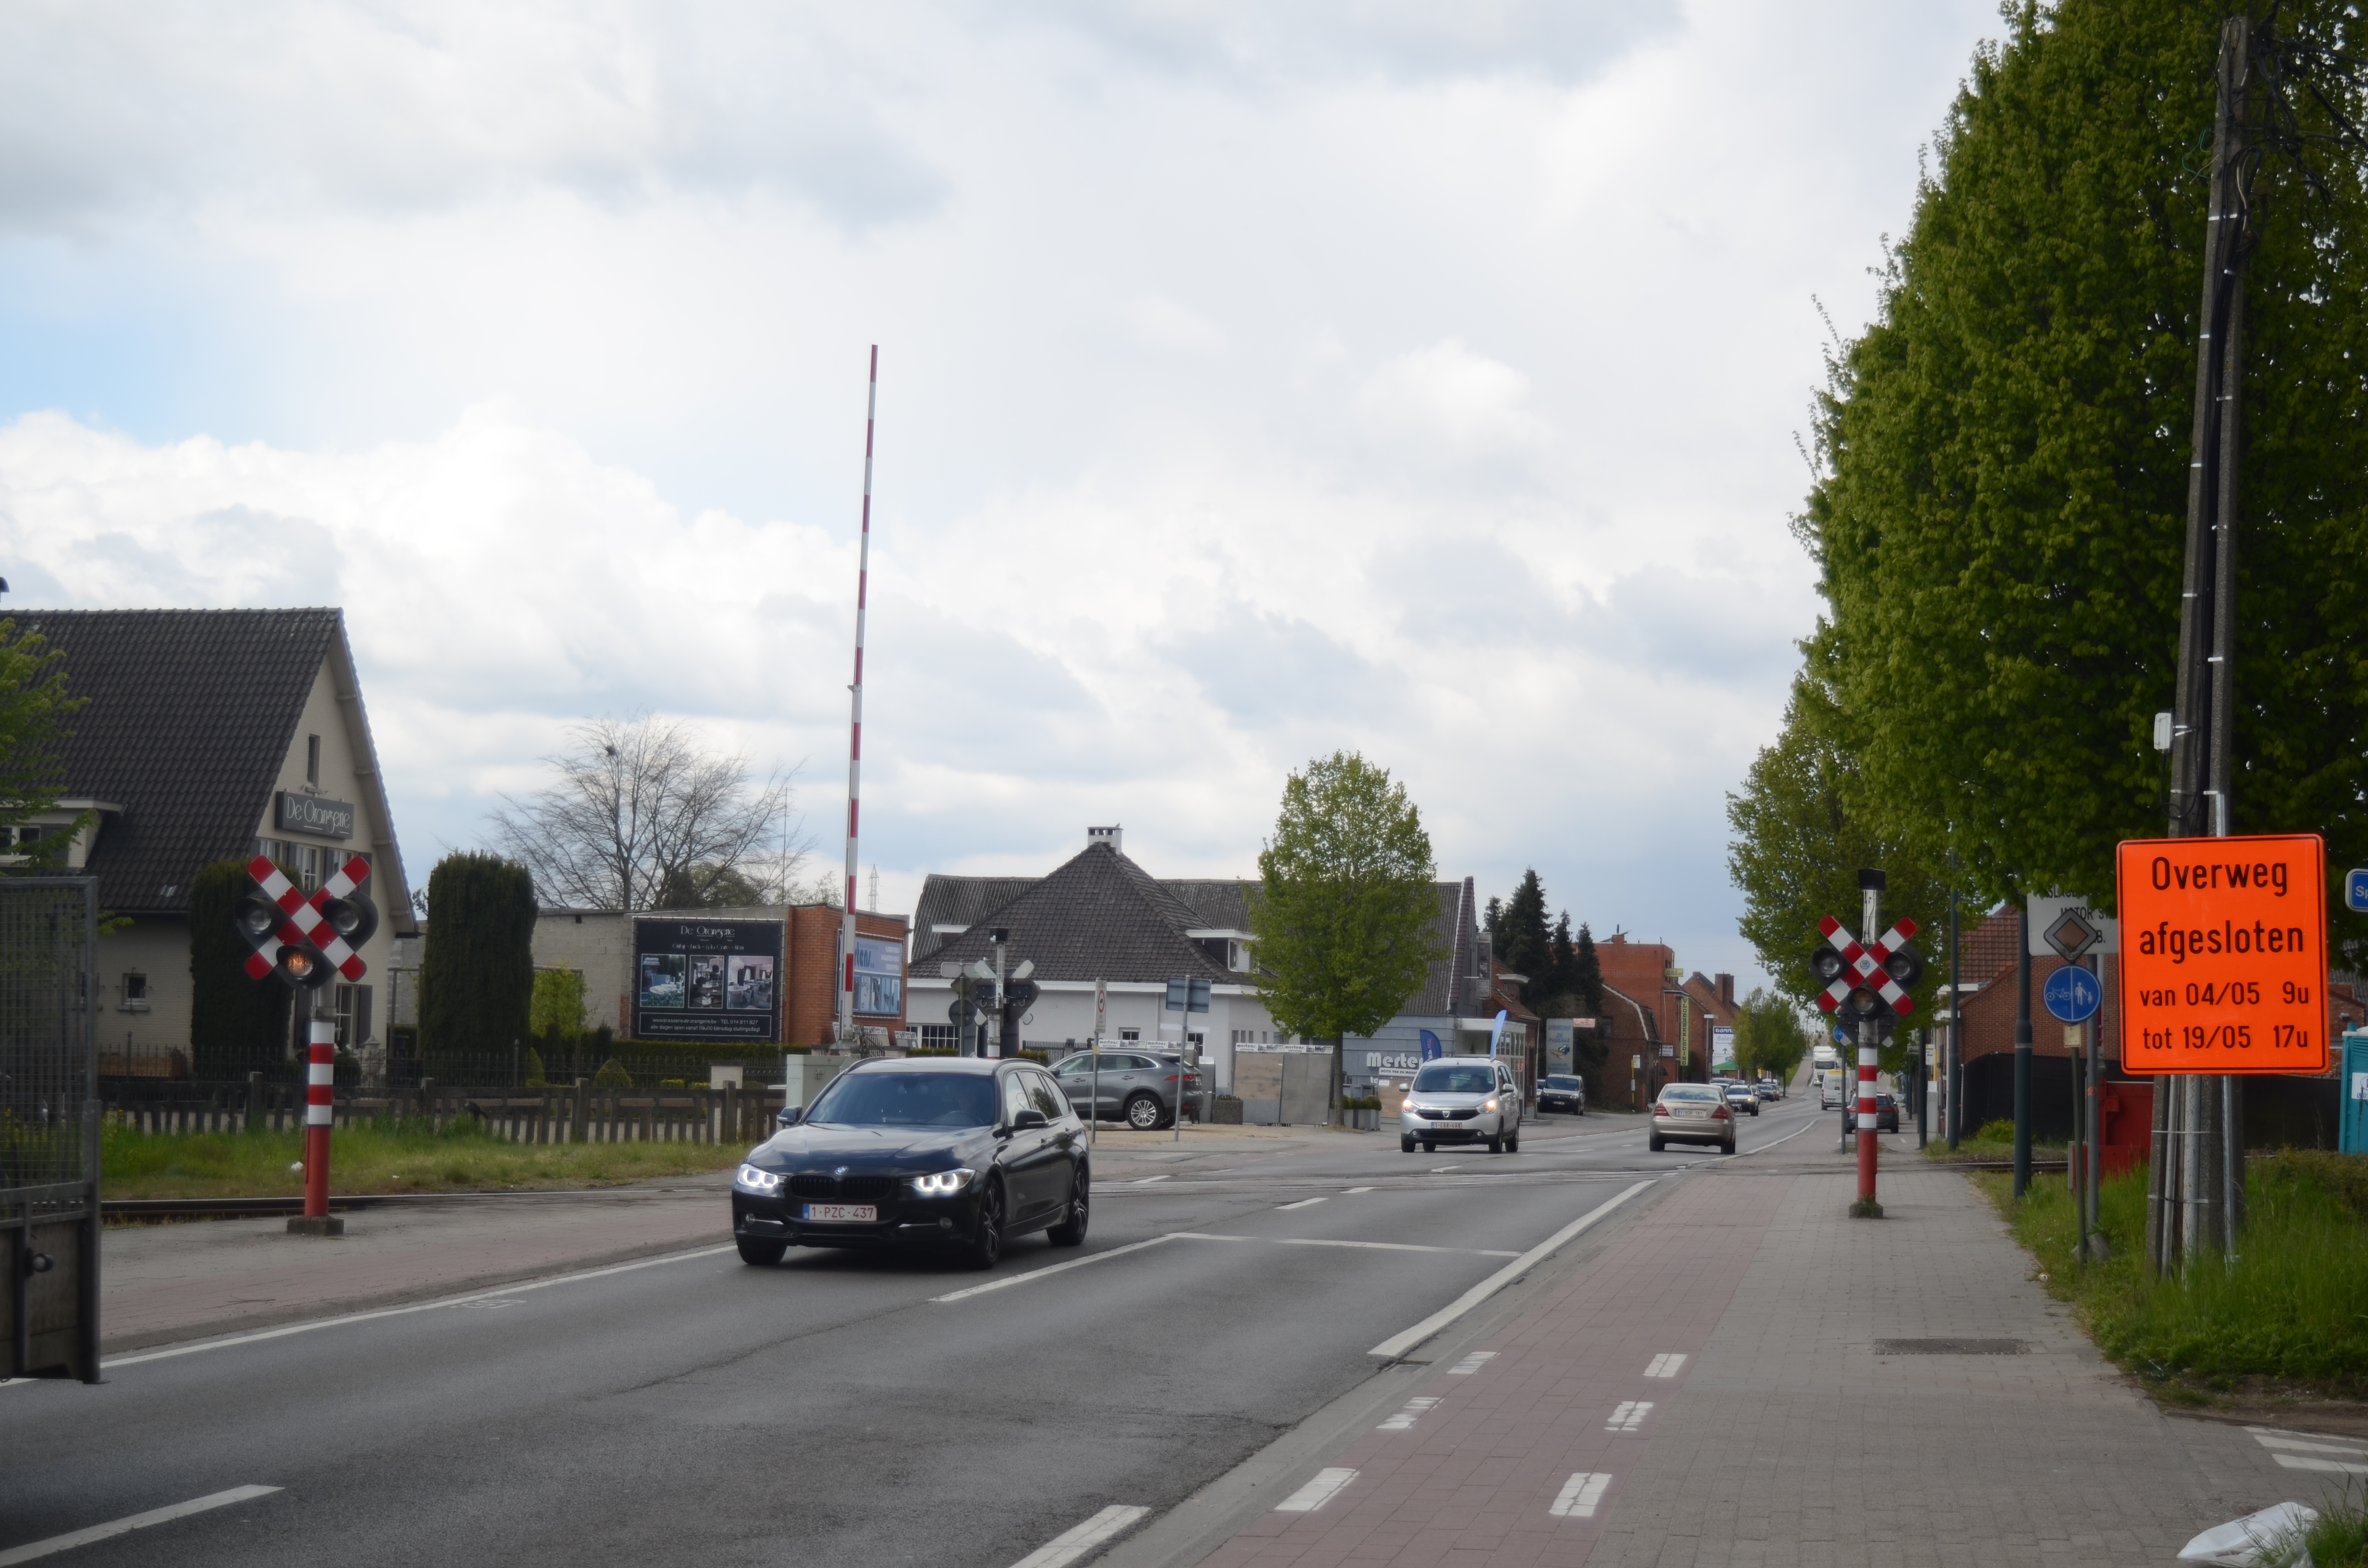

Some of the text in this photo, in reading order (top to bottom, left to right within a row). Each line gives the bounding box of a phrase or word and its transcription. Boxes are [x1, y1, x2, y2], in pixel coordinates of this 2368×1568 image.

[287, 796, 350, 833] De Orangerie
[2151, 856, 2287, 897] Overweg
[681, 925, 735, 938] De Orangerie
[2139, 919, 2303, 964] afgesloten
[2139, 981, 2309, 1006] van 04/05 9u
[2143, 1025, 2308, 1049] tot 19/05 17u
[812, 1206, 874, 1218] 1-PZC-437
